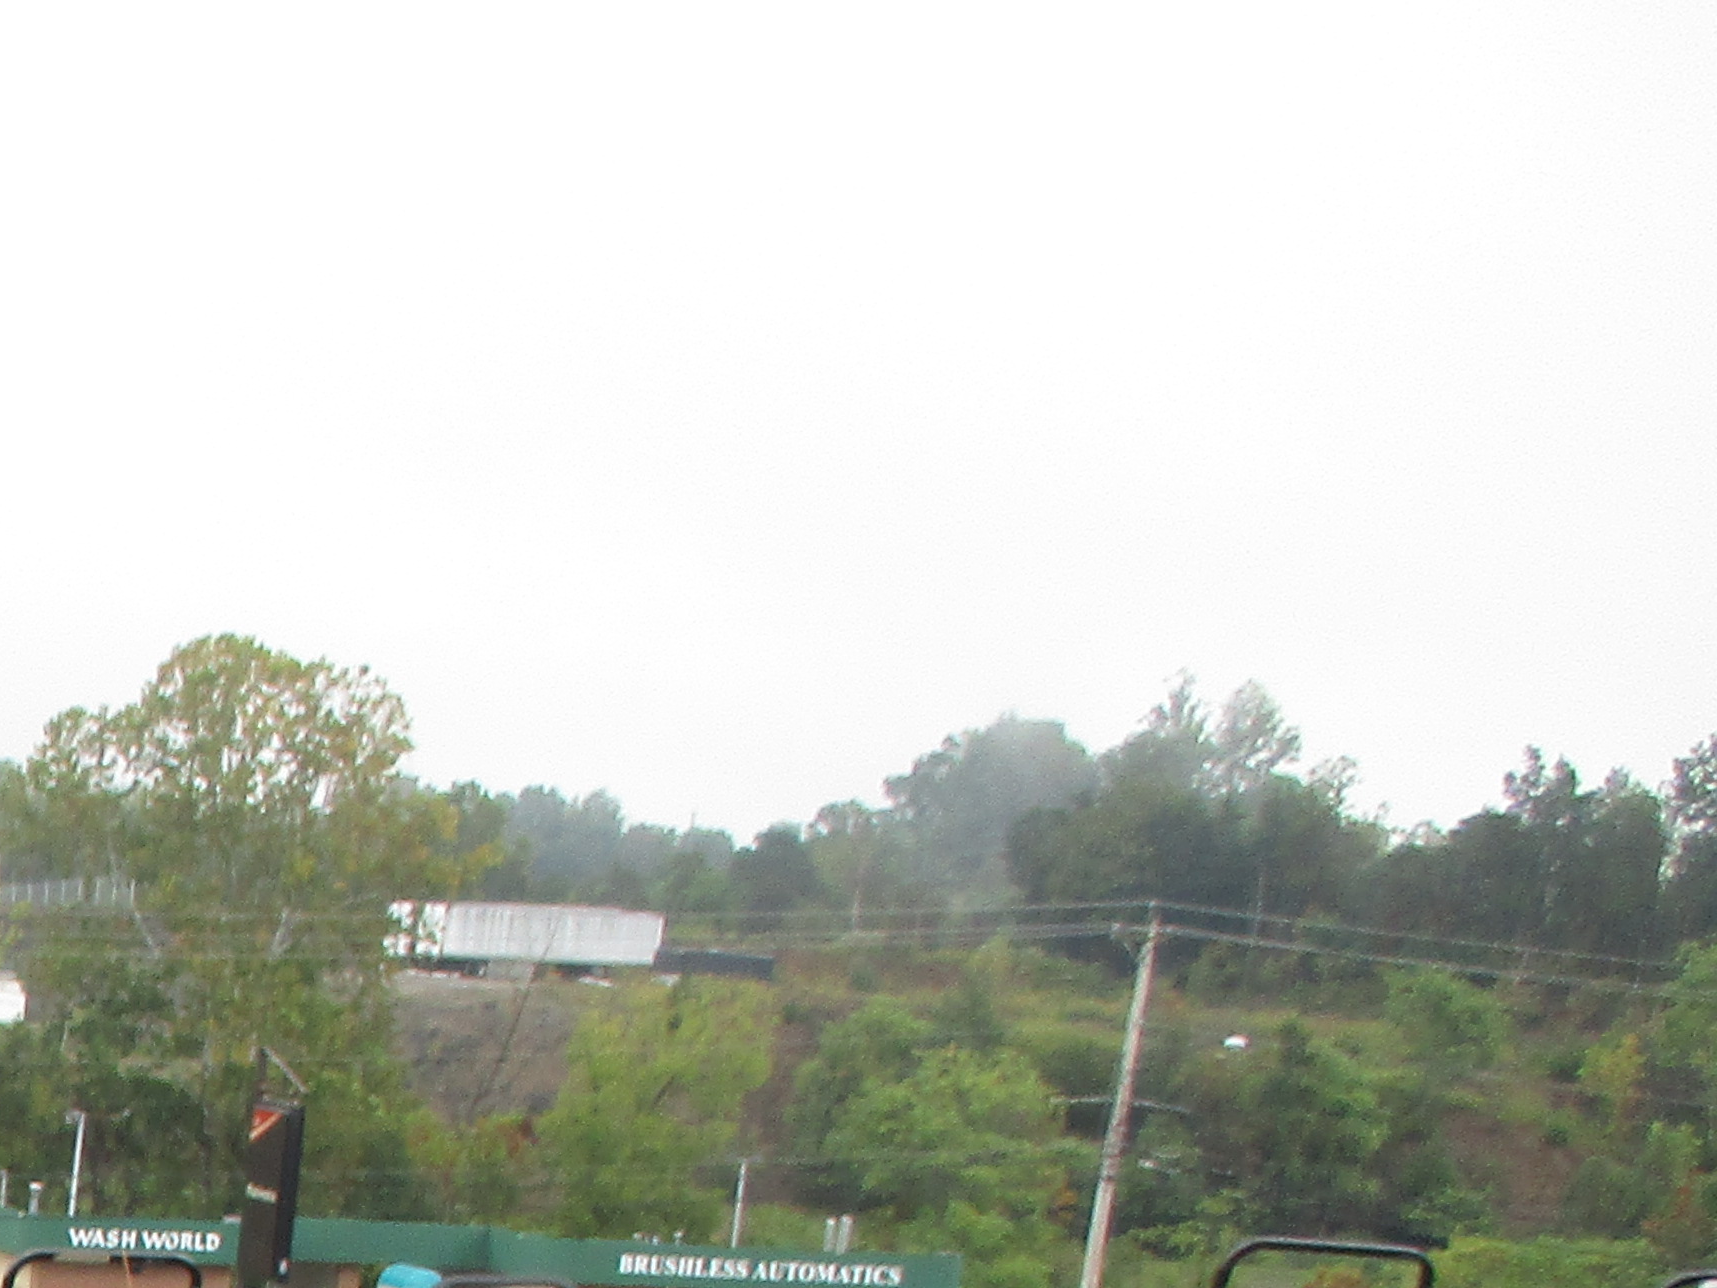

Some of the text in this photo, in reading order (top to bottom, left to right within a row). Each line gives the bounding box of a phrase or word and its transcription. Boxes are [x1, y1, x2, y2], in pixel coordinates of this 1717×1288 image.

[69, 1227, 221, 1252] WASH WORLD
[618, 1252, 903, 1286] BRUSHLESS AUTOMATICS
